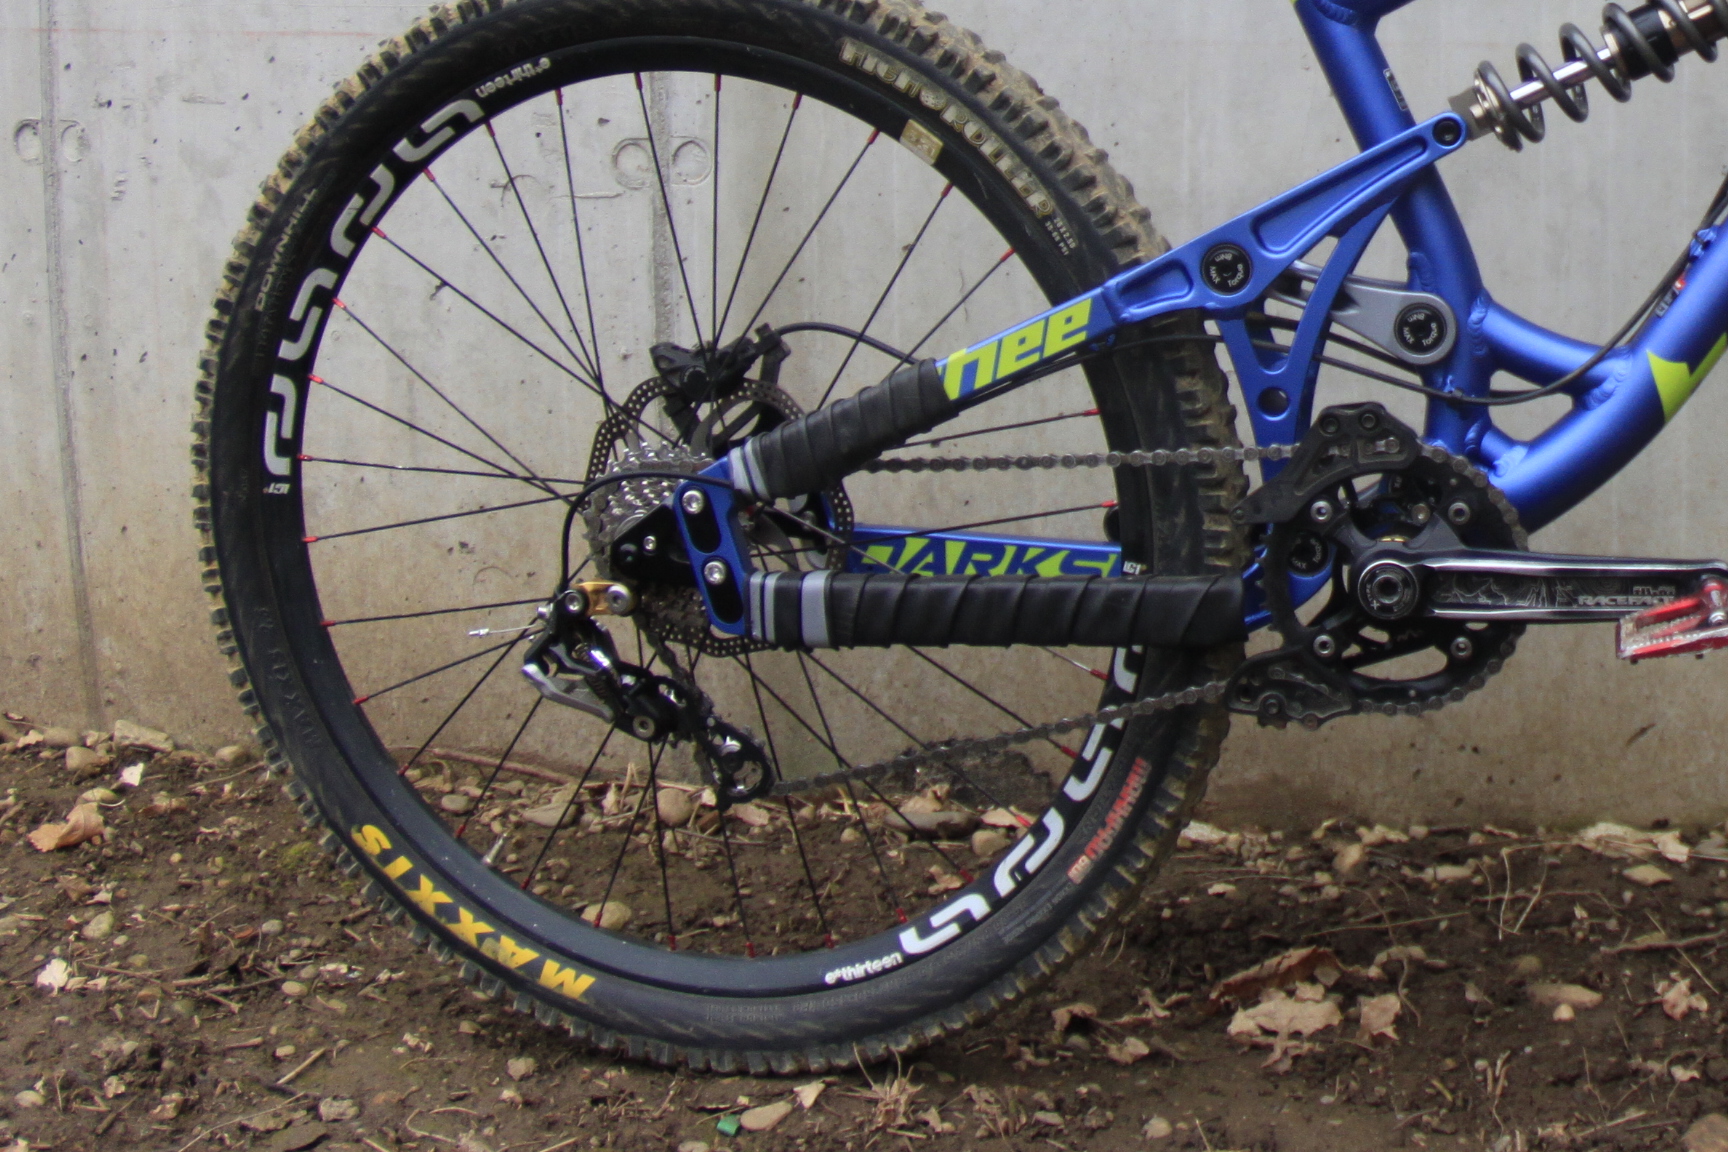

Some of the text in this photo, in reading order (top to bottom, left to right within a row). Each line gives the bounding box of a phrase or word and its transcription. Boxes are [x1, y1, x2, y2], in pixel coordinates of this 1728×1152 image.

[255, 187, 319, 313] DOWNHILL
[1227, 263, 1245, 288] Torque
[1421, 322, 1438, 347] Torque
[350, 823, 597, 1000] MAXXIS
